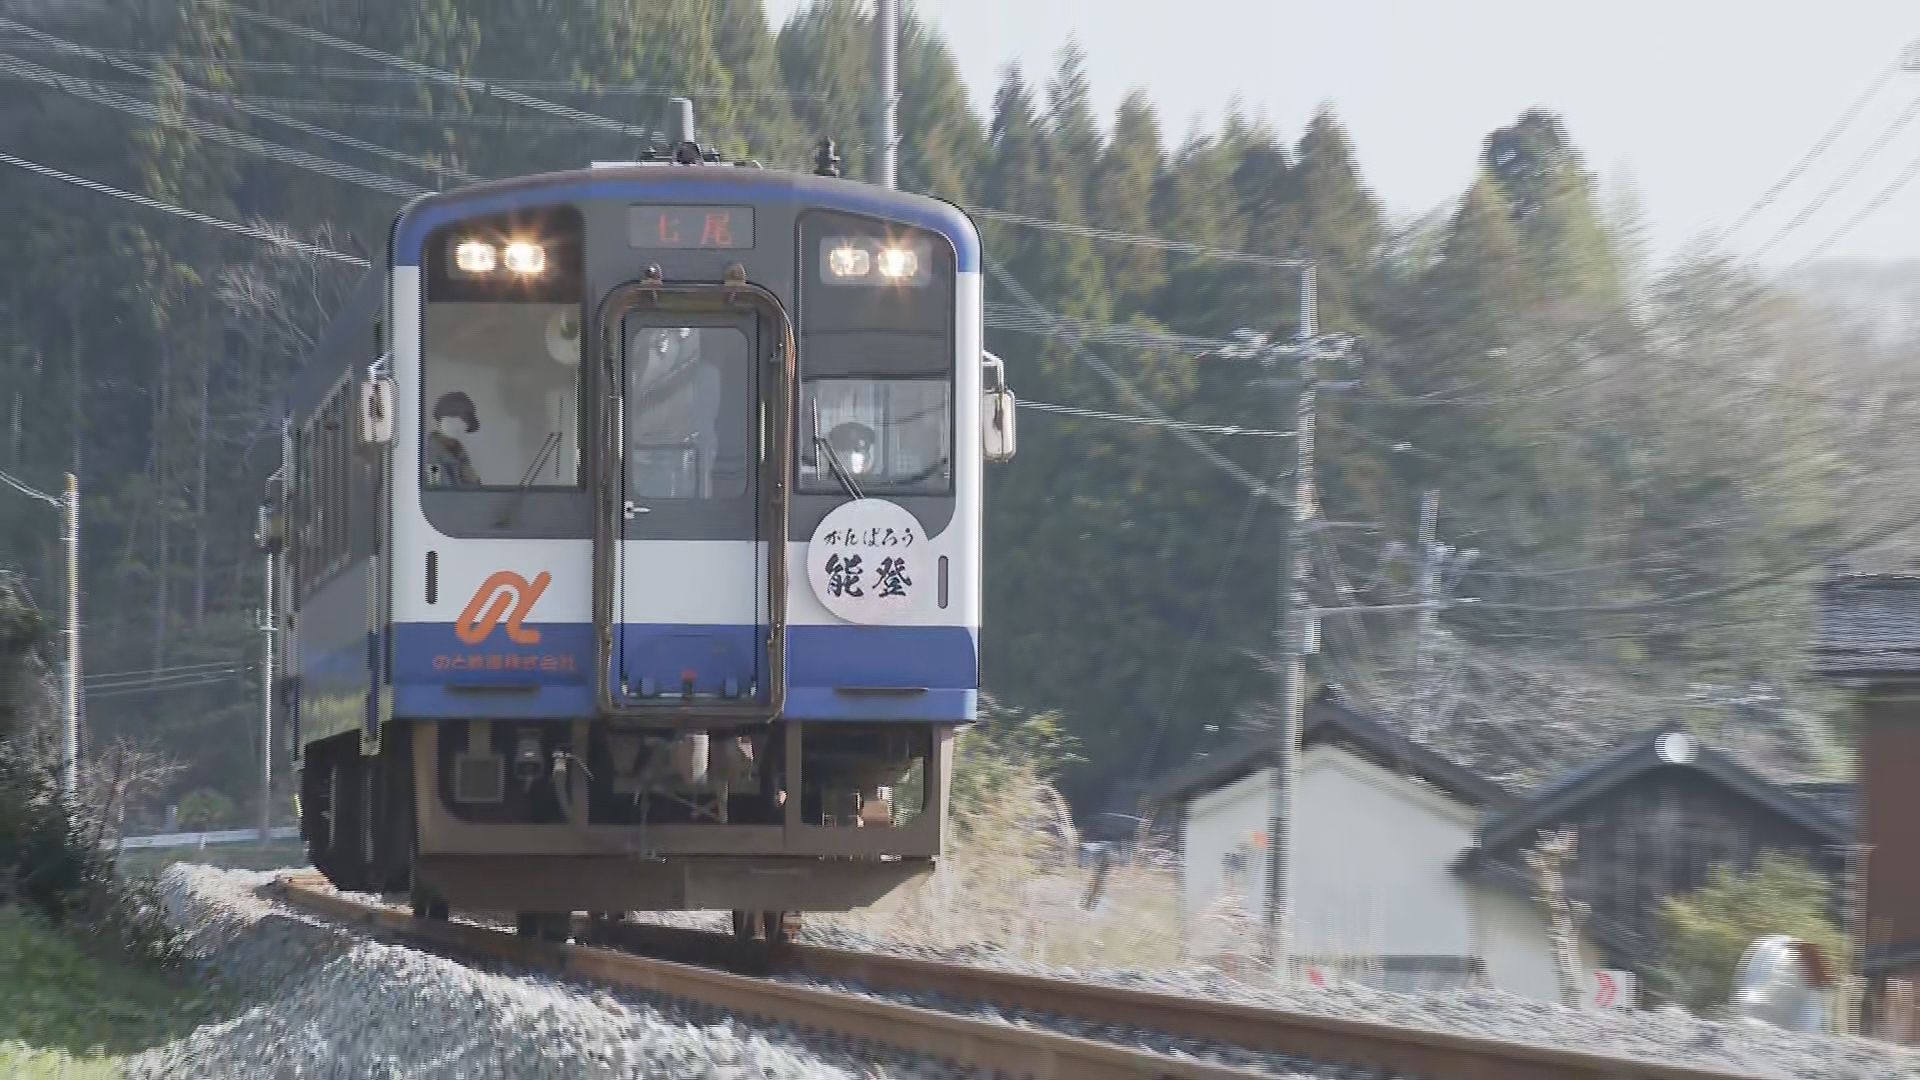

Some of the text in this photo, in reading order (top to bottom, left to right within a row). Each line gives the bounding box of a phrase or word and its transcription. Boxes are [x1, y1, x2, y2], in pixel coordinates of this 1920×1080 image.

[824, 527, 914, 548] がんばろう
[824, 553, 913, 598] 能登
